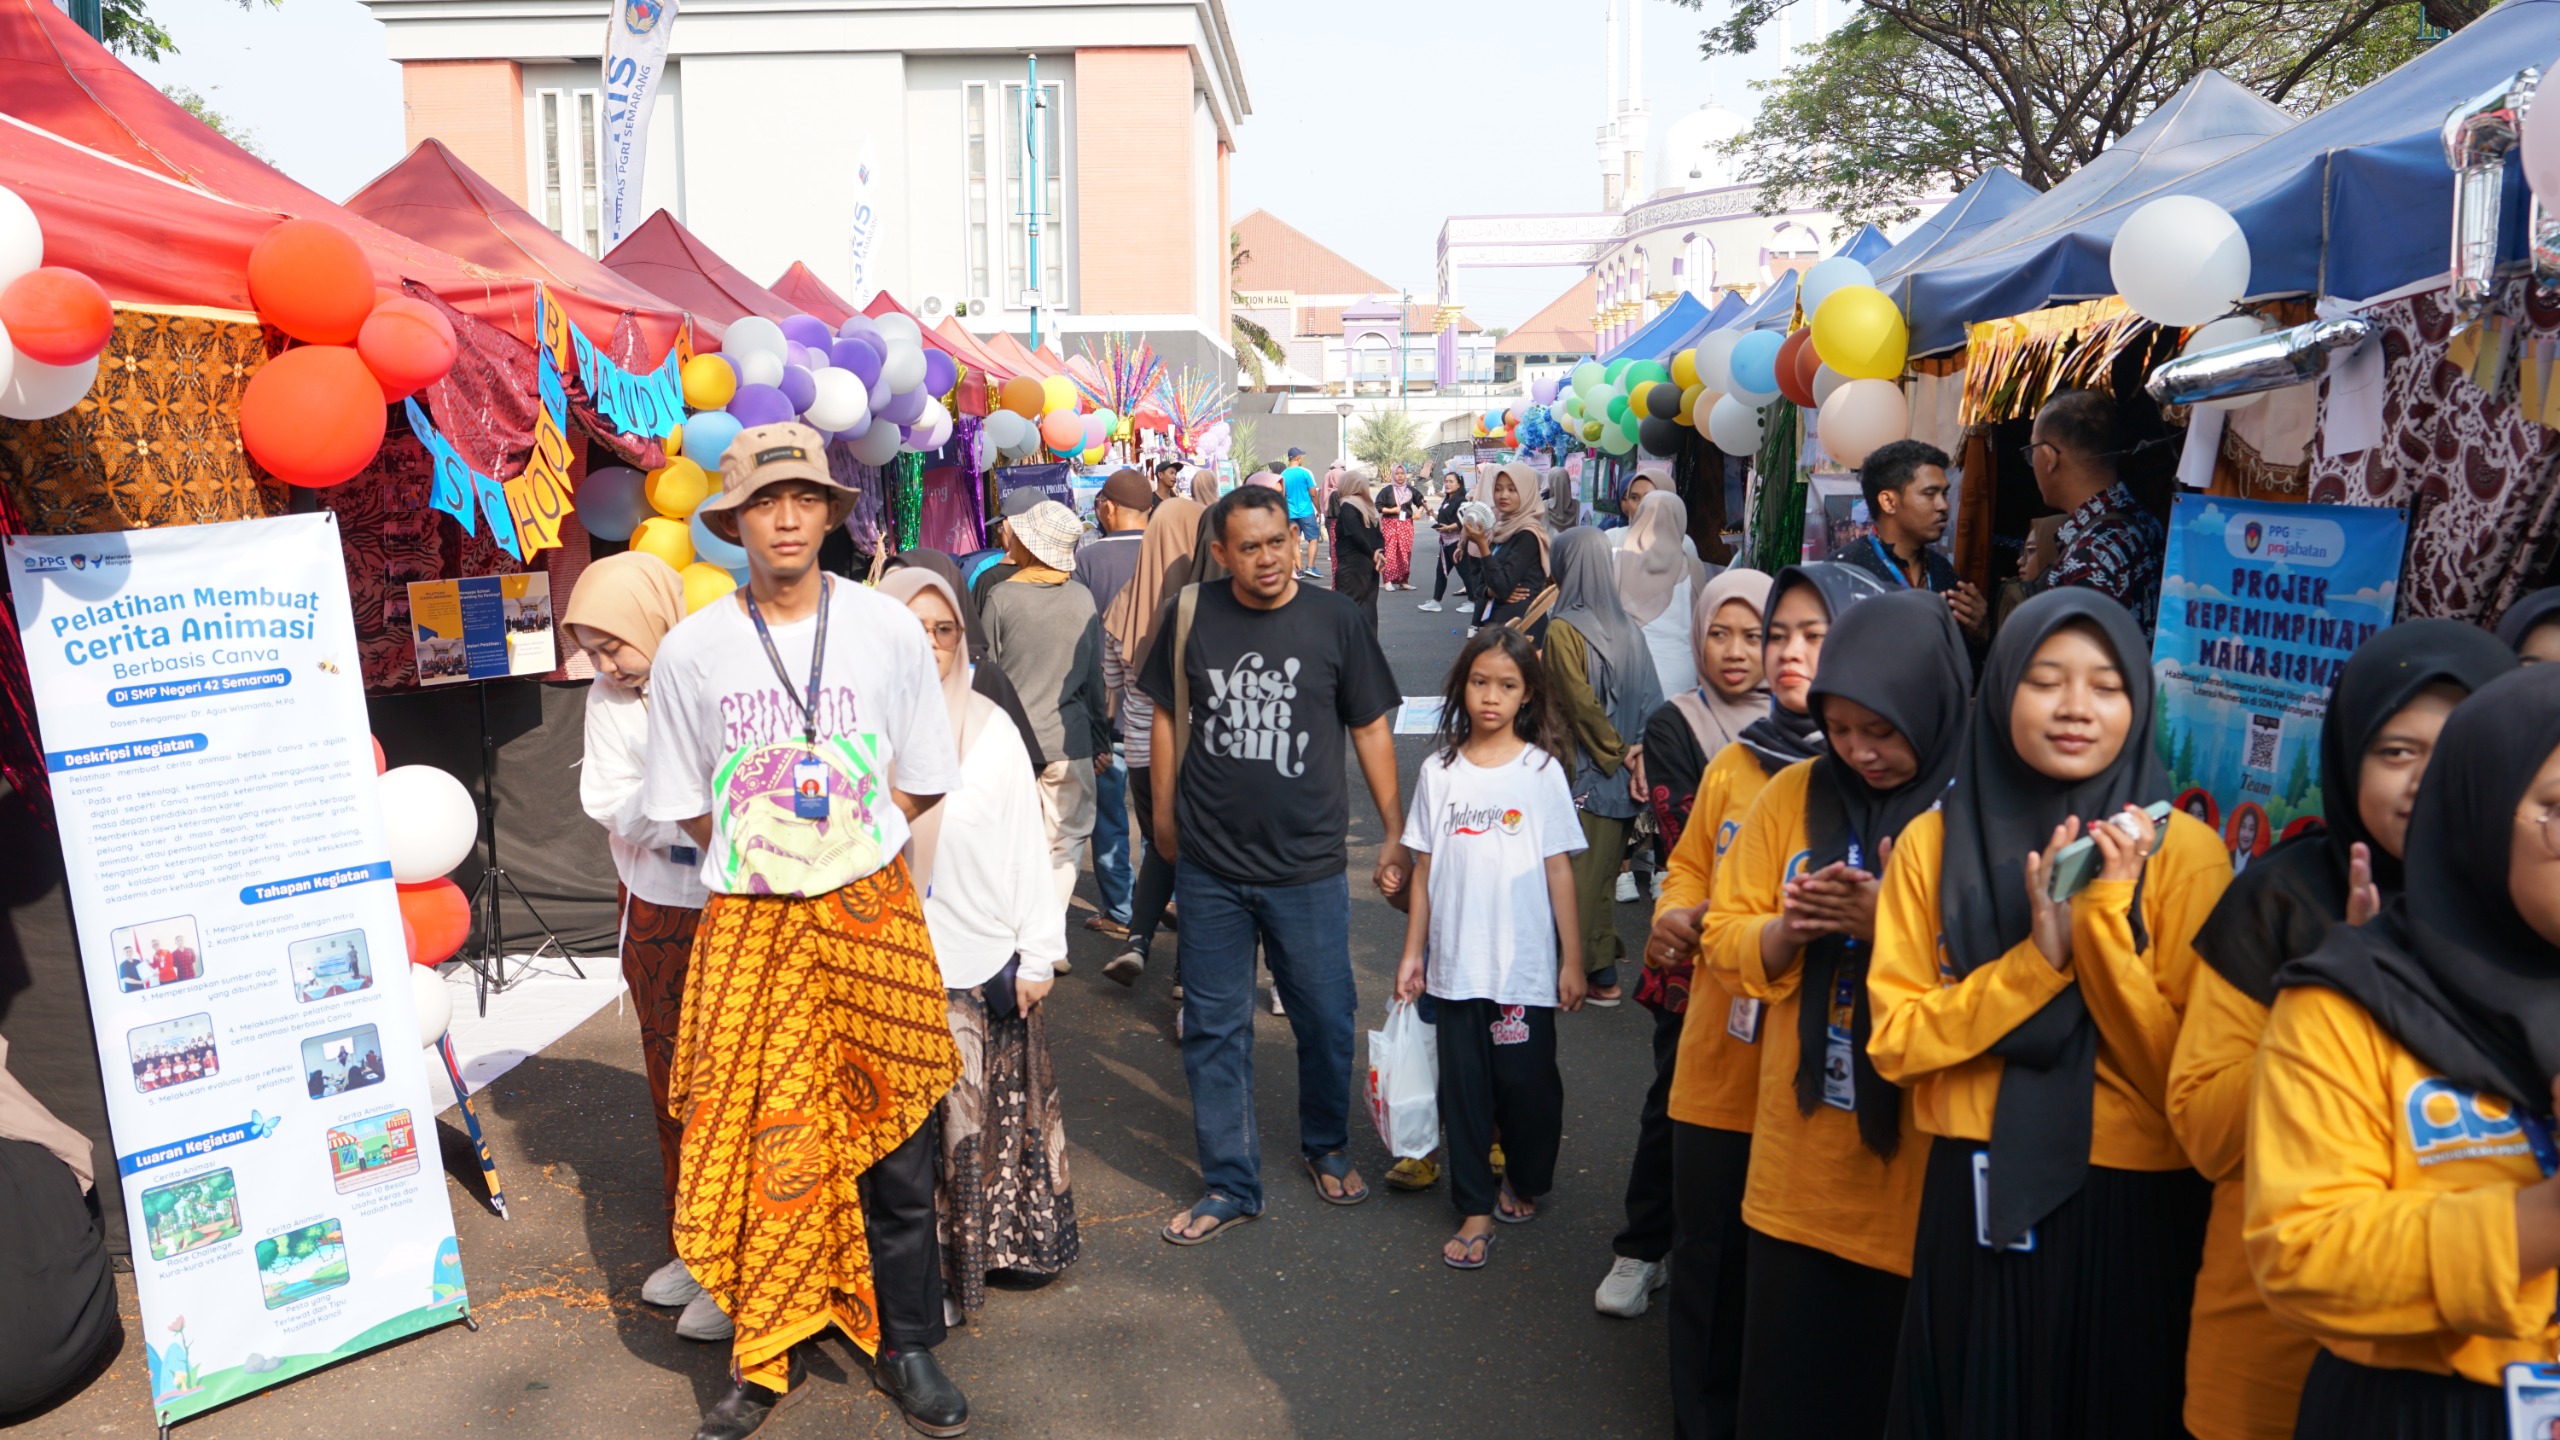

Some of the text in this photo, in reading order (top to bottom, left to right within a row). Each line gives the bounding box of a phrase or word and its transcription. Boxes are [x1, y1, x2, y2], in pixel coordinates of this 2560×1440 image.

[624, 64, 651, 137] SEMARANG
[618, 141, 631, 174] PGRI
[1267, 296, 1288, 304] HALL
[547, 299, 690, 430] BRANDING
[445, 376, 564, 550] SCHOOL
[2269, 525, 2289, 538] PPG
[39, 556, 66, 567] PPG
[2267, 541, 2327, 558] prajabatan
[2231, 567, 2328, 606] PROJEK
[51, 587, 319, 638] Pelatihan Membuat
[2185, 599, 2377, 652] KEPEMIMPINAN
[64, 612, 314, 666] Cerita Animasi
[113, 648, 279, 680] Berbasis Canva
[2199, 639, 2347, 689] MAHASISWA
[115, 672, 285, 702] Di SMP Negeri 42 Semarang
[2193, 686, 2218, 698] Literasi
[2258, 698, 2273, 709] SDN
[2201, 675, 2224, 687] Literasi
[2225, 679, 2257, 693] Numerasi
[2258, 685, 2285, 699] Sebagai
[110, 718, 138, 728] Dosen
[140, 711, 189, 725] Pengampu:
[206, 706, 228, 717] Agus
[229, 700, 274, 712] Wismanto,
[1226, 693, 1292, 731] we
[65, 738, 195, 767] Deskripsi Kegiatan
[69, 772, 111, 784] Pelatihan
[118, 764, 160, 777] membuat
[166, 760, 192, 770] cerita
[198, 755, 231, 765] animasi
[238, 748, 272, 760] berbasis
[277, 743, 303, 753] Canva
[323, 736, 347, 747] dipilih
[88, 796, 112, 806] Pada
[117, 794, 132, 802] era
[186, 777, 240, 791] kemampuan
[244, 772, 267, 782] untuk
[271, 763, 330, 778] menggunakan
[333, 760, 350, 768] alat
[90, 771, 352, 819] digital seperti Canva menjadi keterampilan penting untuk
[2240, 773, 2272, 797] Team
[95, 794, 356, 842] Memberikan siswa keterampilan yang relevan untuk berbagai
[1443, 801, 1504, 837] Indonesia
[255, 869, 369, 900] Tahapan Kegiatan
[213, 912, 294, 936] Mengurus perizinan
[217, 911, 355, 946] Kontrak kerja sama dengan mitra
[151, 967, 277, 1001] Mempersiapkan sumber daya
[208, 978, 279, 1002] yang dibutuhkan
[240, 993, 382, 1031] Melaksanakan pelatihan membuat
[230, 1012, 352, 1046] cerita animasi berbasis Canva
[1490, 1021, 1530, 1045] Barbie
[159, 1064, 294, 1103] Melakukan evaluasi dan refleksi
[256, 1075, 296, 1092] pelatihan
[338, 1103, 395, 1122] Cerita Animasi
[136, 1129, 245, 1168] Luaran Kegiatan
[153, 1160, 216, 1183] Cerita Animasi
[351, 1186, 419, 1211] Usaha Keras dan
[357, 1190, 372, 1199] Misi
[360, 1198, 413, 1217] Hadiah Manis
[266, 1213, 325, 1235] Cerita Animasi
[159, 1248, 244, 1280] Kura-kura vs Kelinci
[167, 1241, 233, 1267] Race Challenge
[274, 1298, 347, 1328] Terlewat dan Tipu
[286, 1294, 331, 1314] Pesta yang
[283, 1309, 342, 1335] Muslihat Kancil
